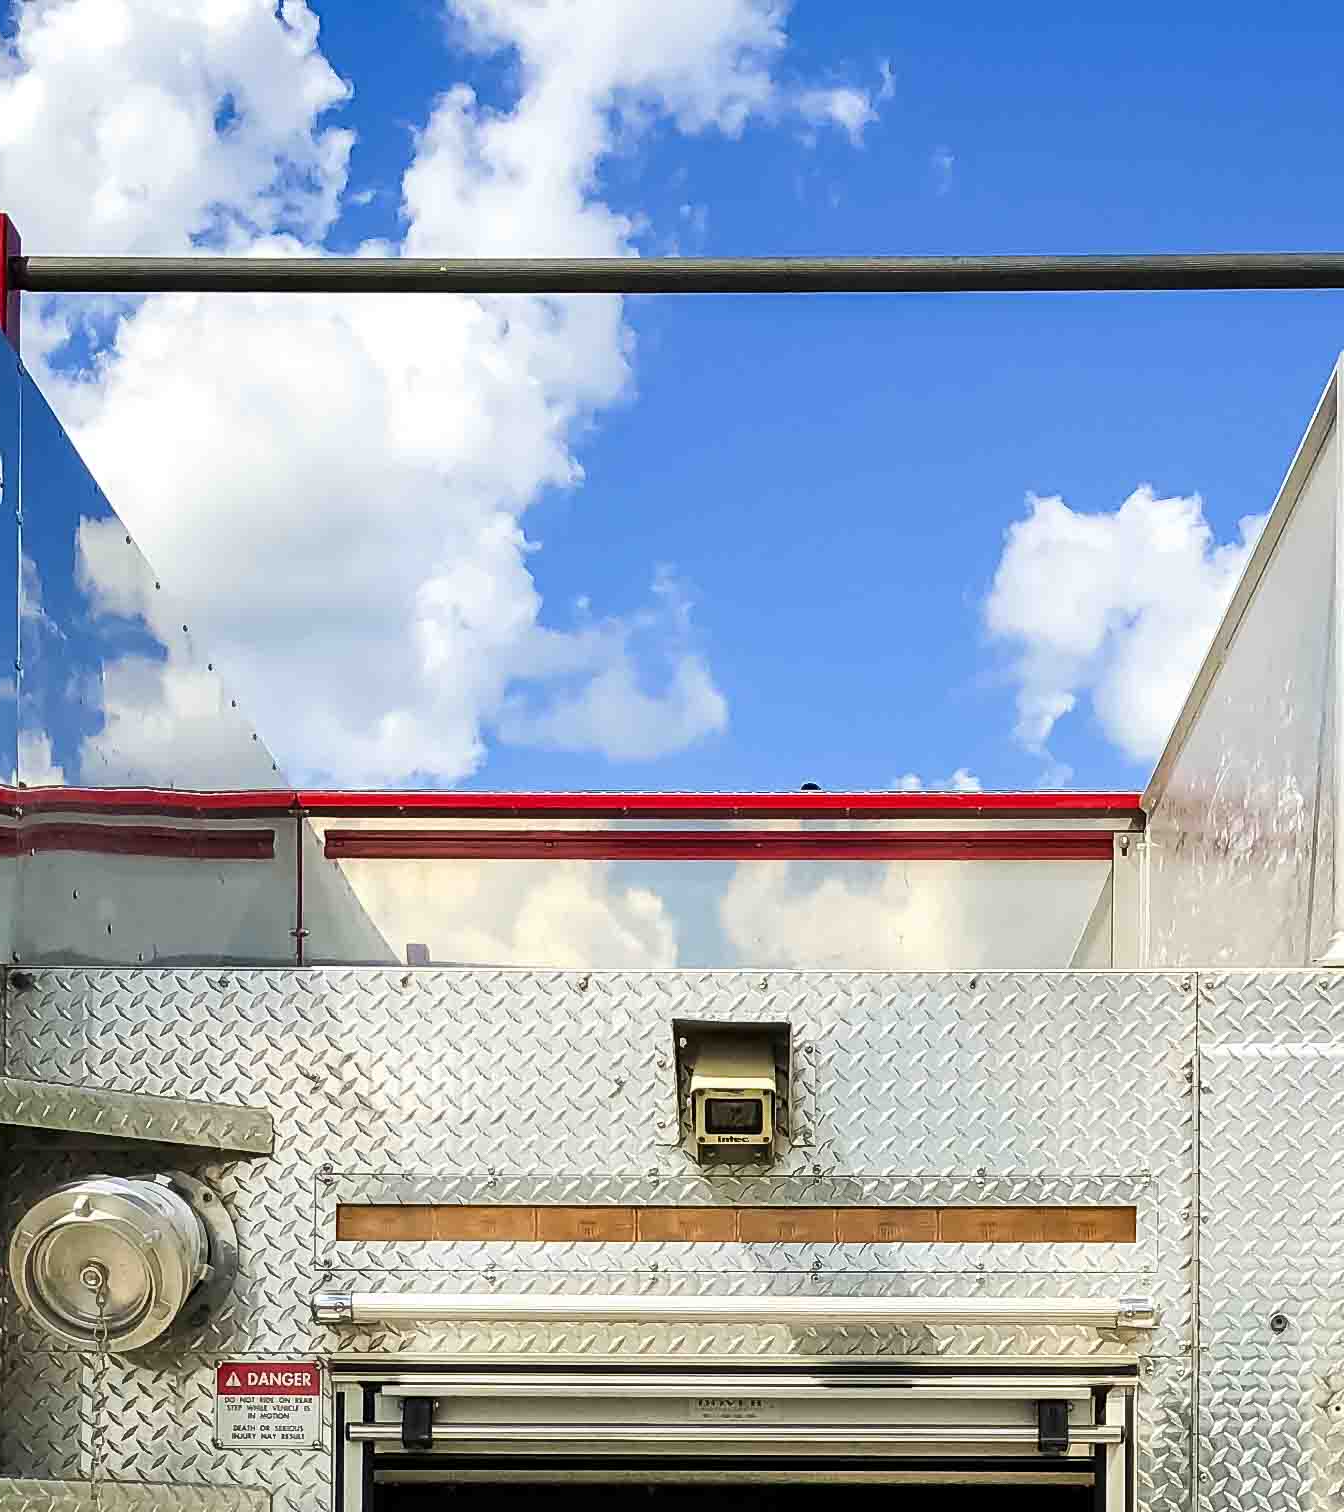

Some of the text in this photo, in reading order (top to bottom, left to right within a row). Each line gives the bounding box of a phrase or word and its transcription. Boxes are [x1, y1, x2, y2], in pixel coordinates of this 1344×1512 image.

[717, 1135, 750, 1143] intec
[247, 1372, 311, 1386] DANGER
[224, 1396, 235, 1404] DO
[240, 1396, 255, 1404] NOT
[279, 1396, 291, 1404] ON
[226, 1404, 242, 1412] STEP
[247, 1404, 268, 1412] WHILE
[232, 1424, 304, 1432] DEATH OR SERIOUS
